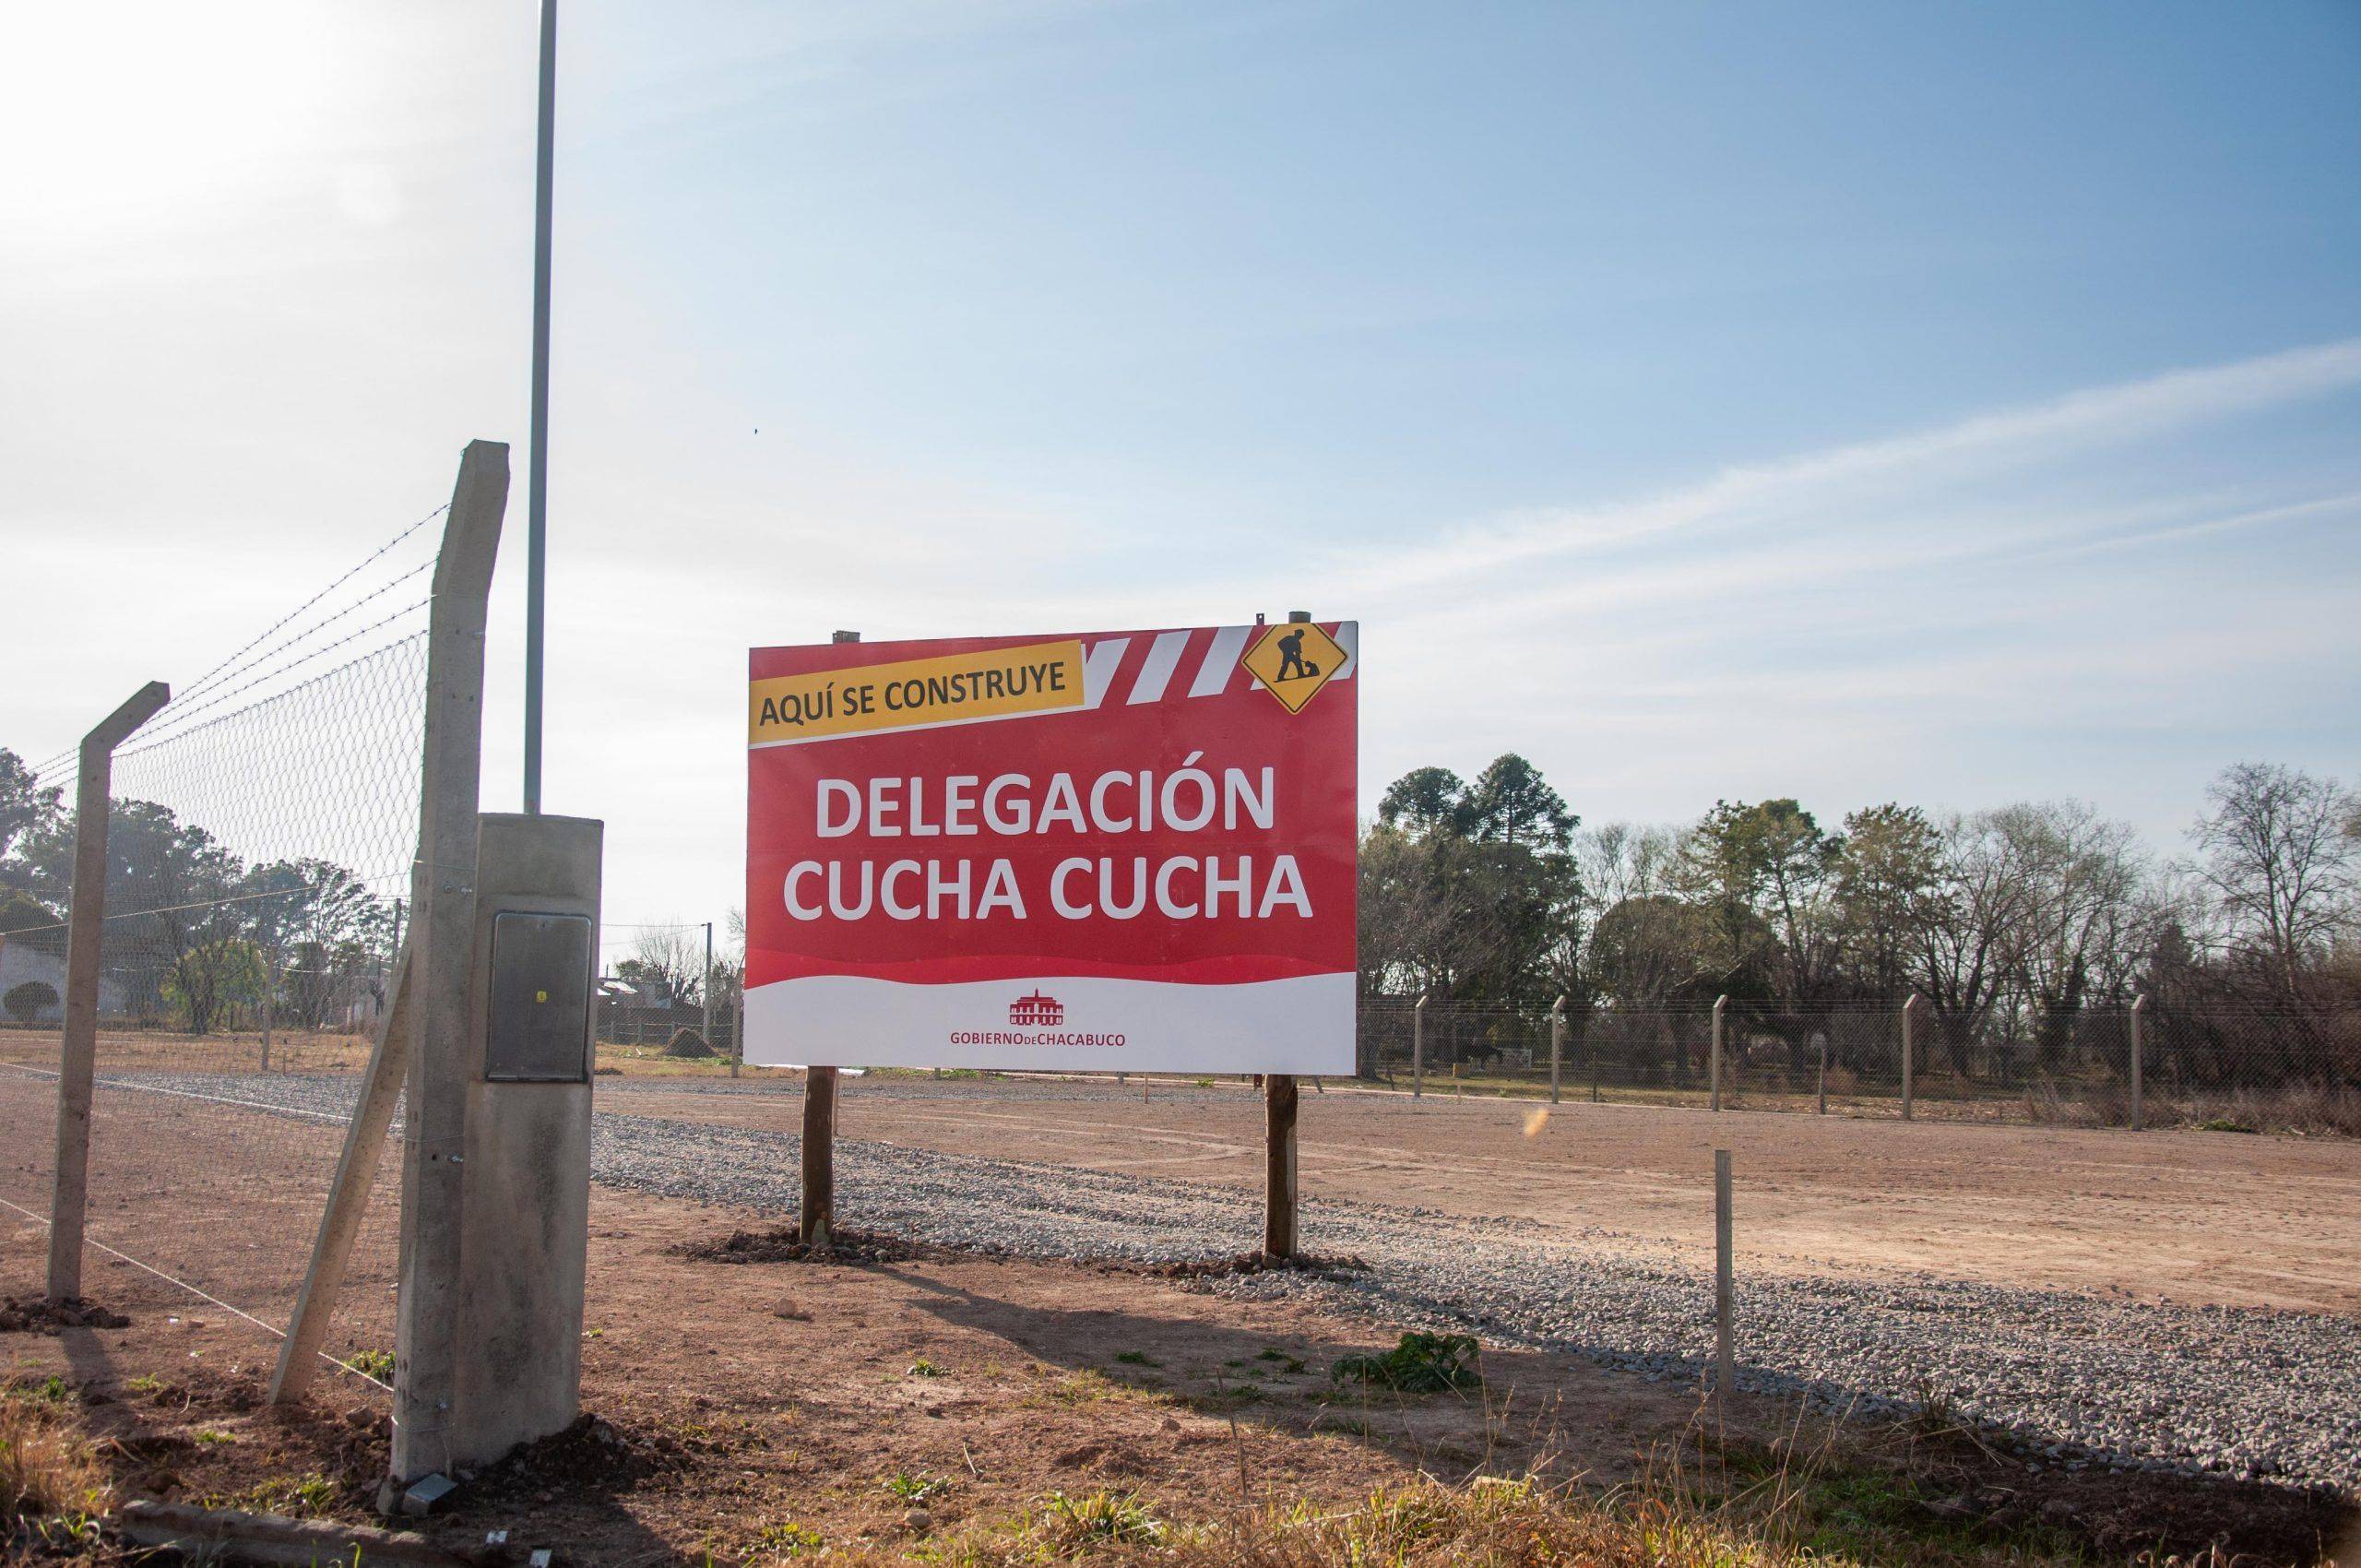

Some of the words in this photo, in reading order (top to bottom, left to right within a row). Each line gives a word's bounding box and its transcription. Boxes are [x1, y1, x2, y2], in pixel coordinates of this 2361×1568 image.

[759, 681, 834, 726] AQUÍ
[842, 684, 875, 717] SE
[884, 660, 1066, 711] CONSTRUYE
[816, 750, 1275, 837] DELEGACIÓN
[783, 859, 1027, 921] CUCHA
[1050, 854, 1313, 920] CUCHA
